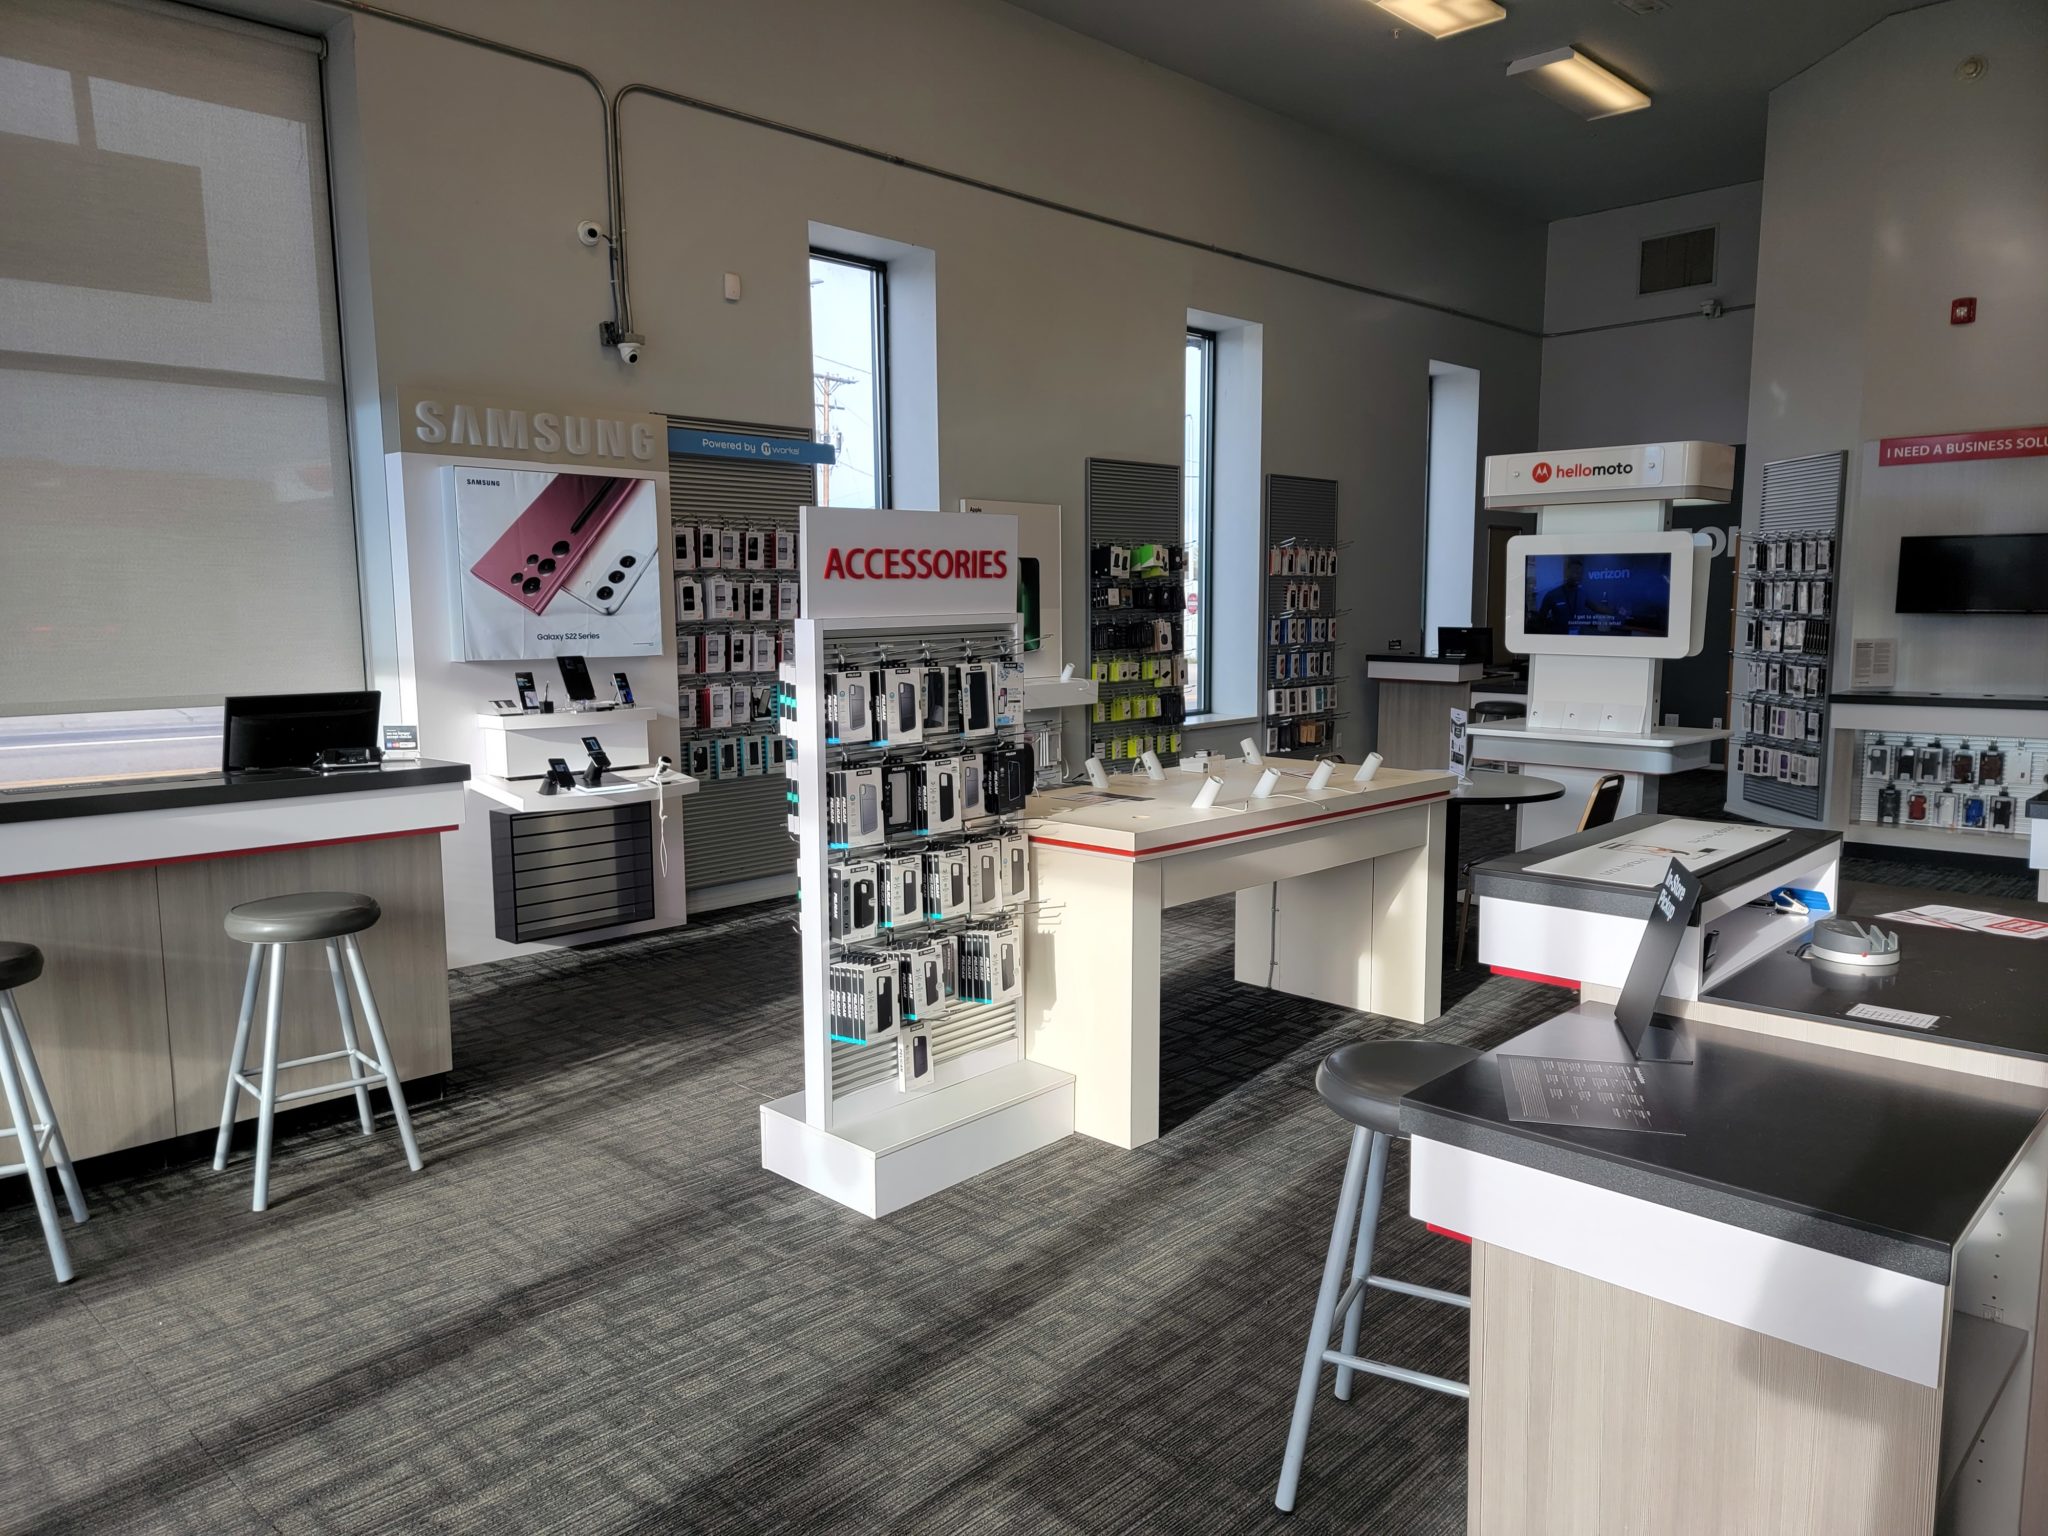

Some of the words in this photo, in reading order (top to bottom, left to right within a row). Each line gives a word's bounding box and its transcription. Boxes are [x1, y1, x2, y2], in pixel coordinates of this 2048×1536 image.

[415, 401, 655, 460] SAMSUNG
[702, 439, 742, 450] Powered
[744, 442, 756, 453] by
[1894, 445, 1930, 458] NEED
[1933, 444, 1943, 455] A
[1946, 439, 2013, 454] BUSINESS
[1556, 462, 1633, 478] hellomoto
[466, 478, 501, 487] SAMSUNG
[824, 547, 1008, 580] ACCESSORIES
[1588, 567, 1630, 581] verizon
[537, 633, 564, 642] Galaxy
[565, 632, 577, 640] S22
[578, 632, 600, 640] Series
[1665, 868, 1686, 901] In-Store
[1658, 888, 1676, 922] Pickup
